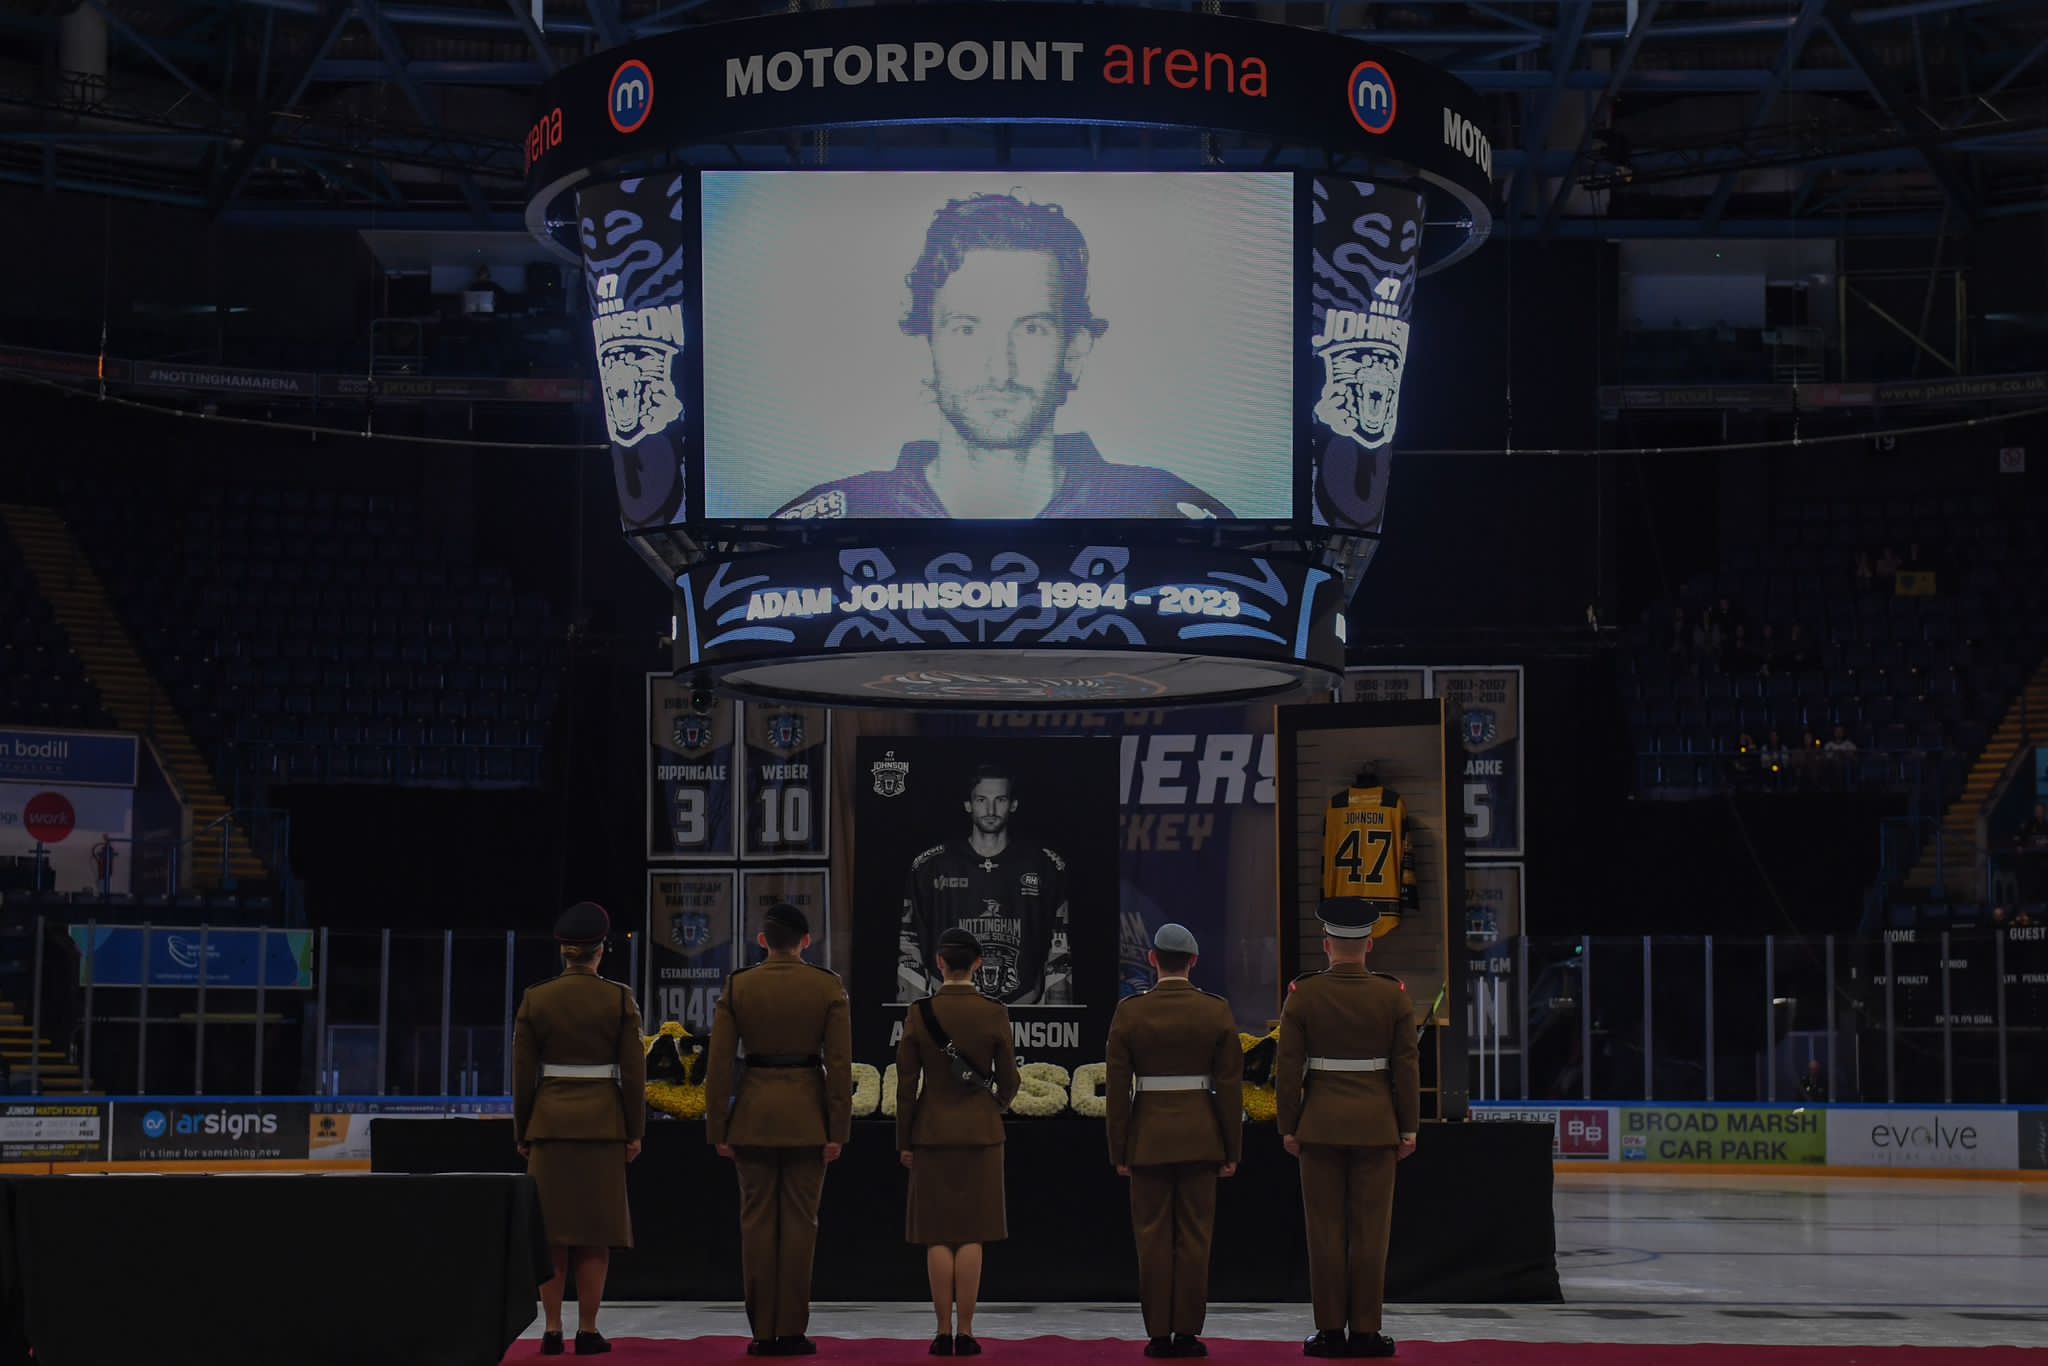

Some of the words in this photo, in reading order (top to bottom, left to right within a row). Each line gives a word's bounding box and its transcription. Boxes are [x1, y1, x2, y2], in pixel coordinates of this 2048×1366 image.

[724, 40, 1084, 98] MOTORPOINT
[1102, 43, 1269, 97] arena
[150, 369, 299, 391] #NOTTINGHAMARENA
[746, 587, 833, 621] ADAM
[840, 581, 1018, 613] JOHNSON
[1037, 582, 1127, 609] 1994
[1158, 586, 1240, 617] 2023
[15, 739, 69, 759] bodill
[656, 764, 728, 781] RIPPINGALE
[761, 763, 809, 780] WEBER
[1463, 759, 1504, 776] ARKE
[674, 787, 706, 843] 3
[760, 787, 810, 843] 10
[1343, 811, 1385, 825] JOHNSON
[1334, 828, 1393, 885] 47
[957, 917, 1022, 938] NOTTINGHAM
[2009, 927, 2048, 941] GUEST
[660, 967, 721, 979] ESTABLISHED
[1490, 957, 1512, 973] GM
[1897, 975, 1928, 985] PENALTY
[1011, 1021, 1080, 1048] NSON
[175, 1108, 278, 1141] arsigns
[1629, 1112, 1718, 1132] BROAD
[1727, 1112, 1817, 1133] MARSH
[1871, 1116, 1978, 1149] evolve
[184, 1149, 199, 1159] for
[259, 1150, 281, 1159] new
[1659, 1139, 1713, 1160] CAR
[1721, 1140, 1789, 1162] PARK
